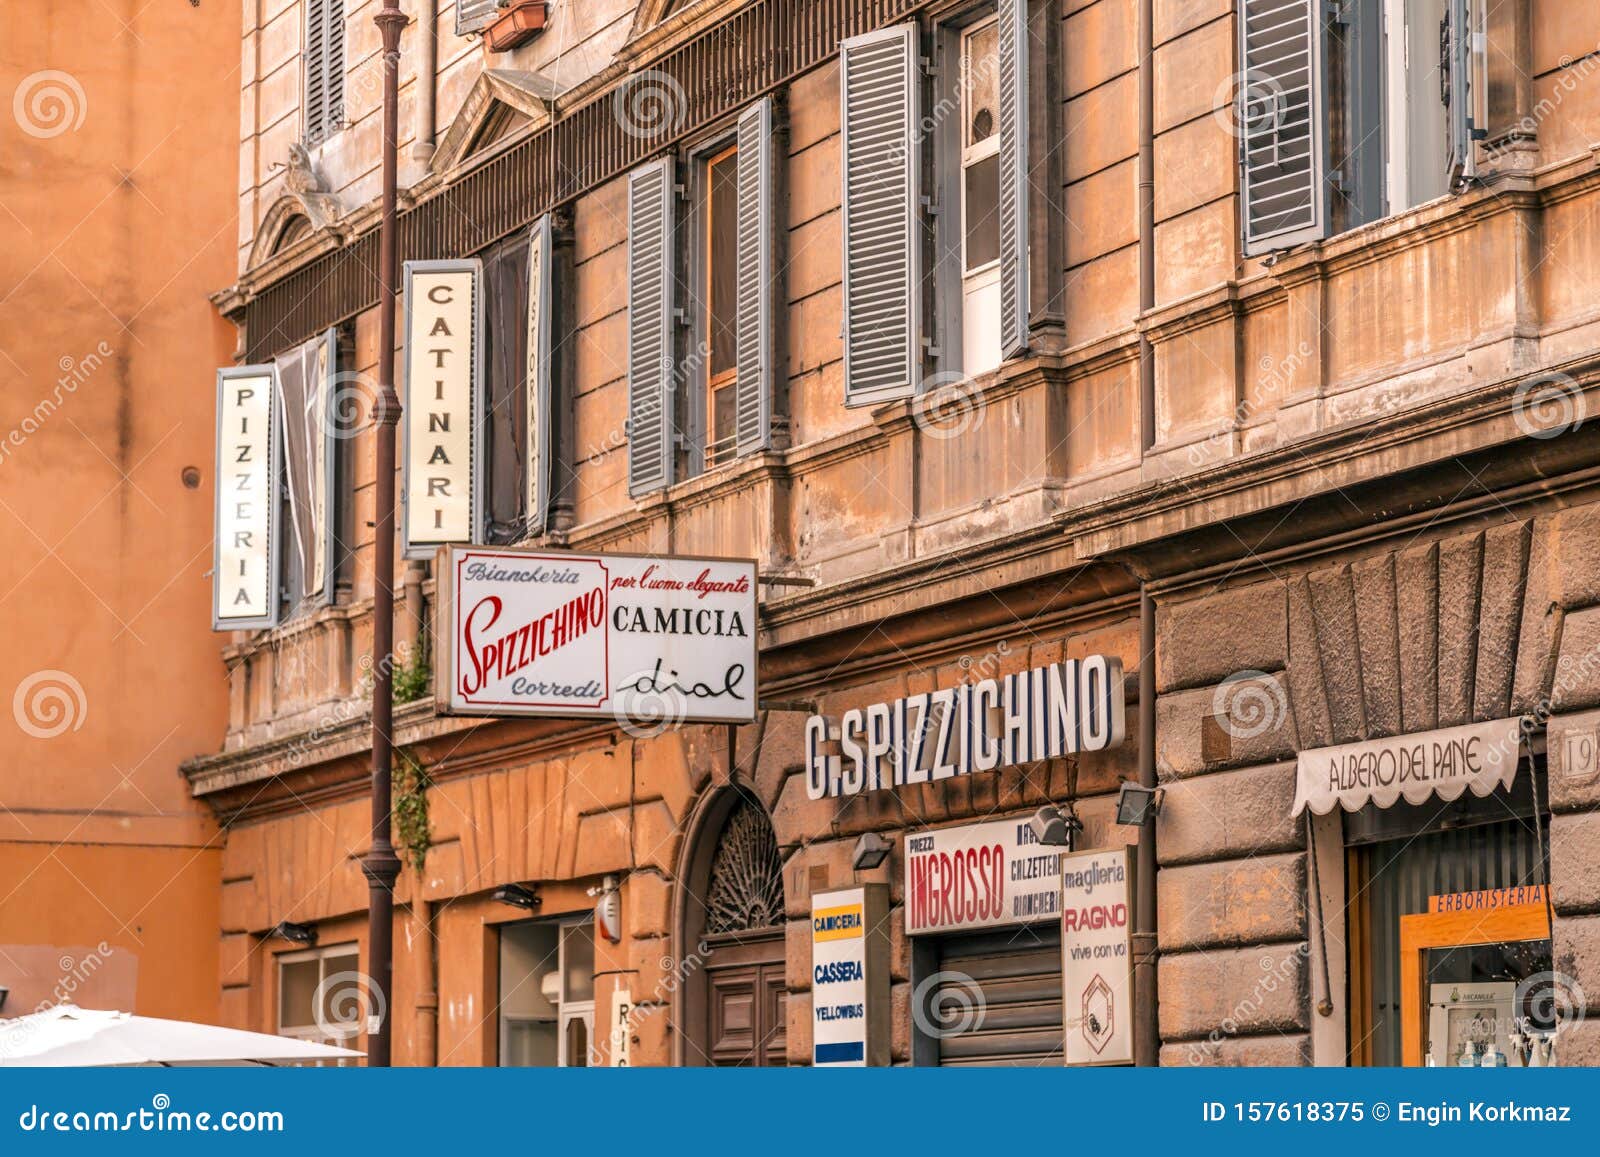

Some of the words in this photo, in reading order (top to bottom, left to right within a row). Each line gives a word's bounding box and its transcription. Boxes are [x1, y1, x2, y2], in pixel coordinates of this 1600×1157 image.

[427, 285, 454, 528] CATINARI
[234, 389, 255, 605] PIZZERIA
[465, 562, 580, 584] Biancheria
[611, 576, 636, 591] per
[640, 564, 684, 590] l'uomo
[687, 568, 750, 599] elegante
[613, 605, 748, 637] CAMICIA
[511, 677, 602, 698] Corredi
[616, 658, 745, 700] dial
[1329, 749, 1398, 792] ALBERO
[1400, 744, 1429, 782] DEL
[1433, 736, 1482, 778] PANE
[1568, 738, 1591, 770] 19
[910, 837, 934, 853] PREZZI
[910, 844, 1004, 929] INGROSSO
[1065, 859, 1125, 894] maglieria
[1437, 885, 1542, 913] ERBORISTERIA
[814, 912, 861, 933] CAMICERIA
[1065, 903, 1127, 933] RAGNO
[1070, 943, 1092, 961] vive
[1094, 943, 1112, 957] con
[1114, 939, 1127, 956] voi
[815, 961, 863, 985] CASSERA
[816, 1004, 864, 1022] YELLOWBUS
